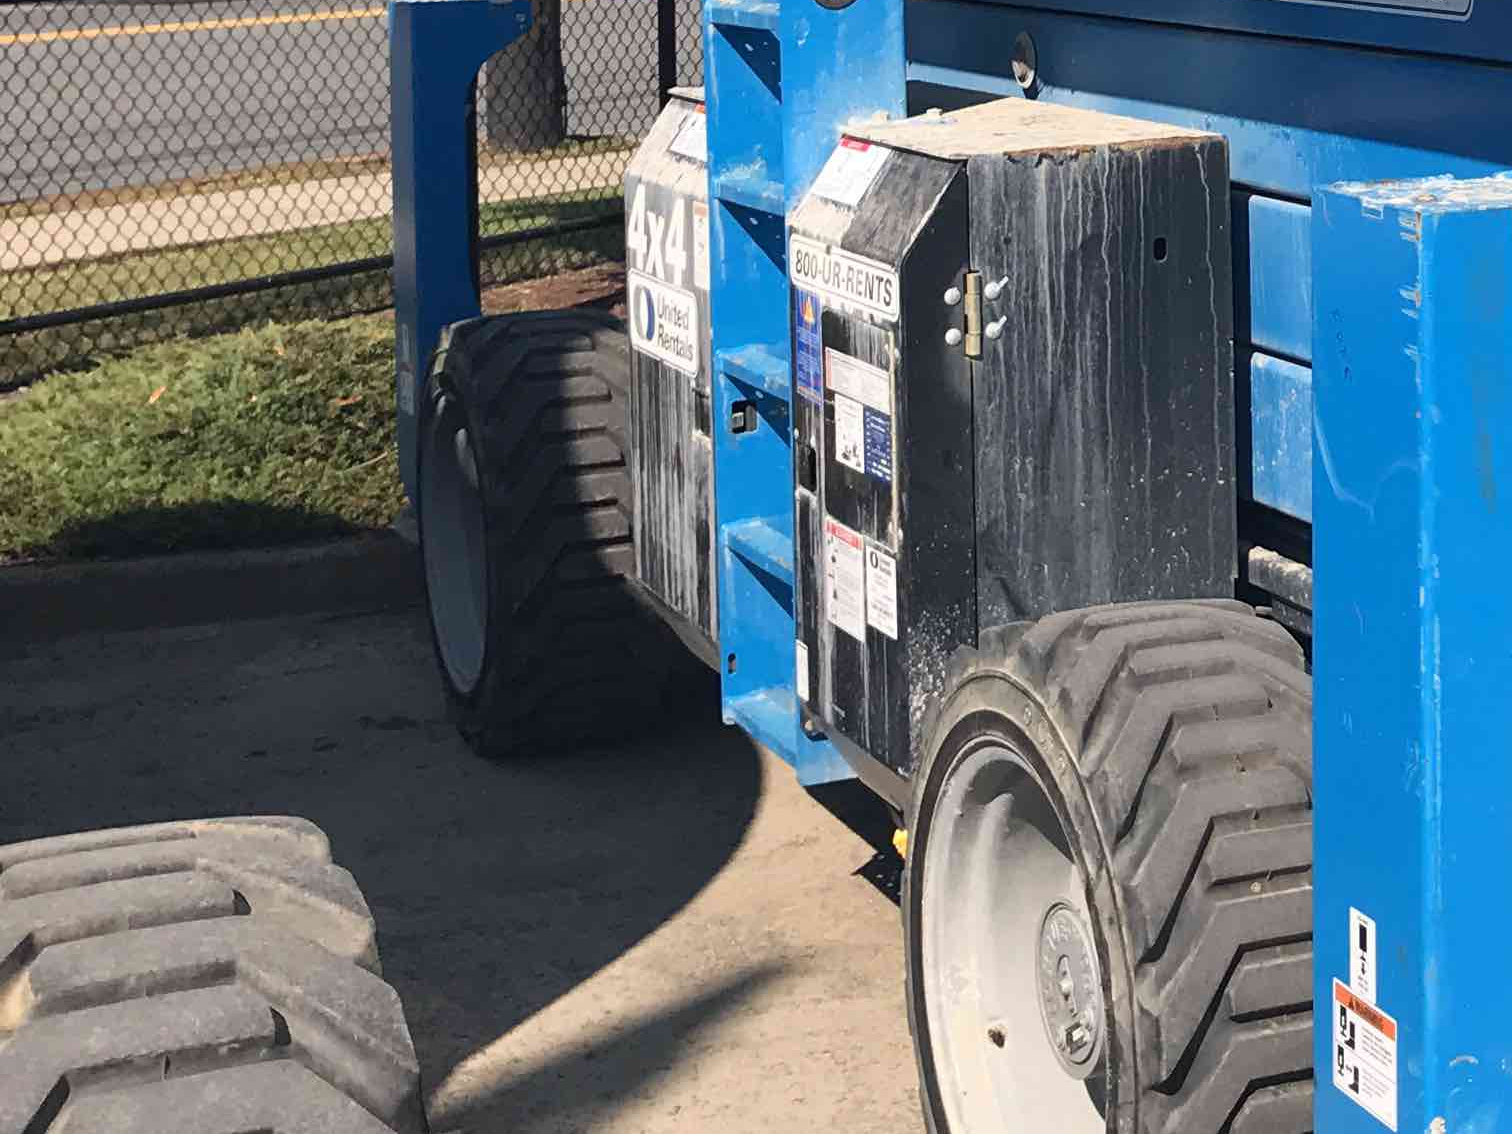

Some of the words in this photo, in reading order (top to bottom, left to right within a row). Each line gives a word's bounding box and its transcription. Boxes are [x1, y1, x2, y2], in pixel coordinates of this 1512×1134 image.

[795, 249, 893, 307] 800-UR-RENTS
[656, 293, 690, 331] United
[657, 323, 694, 363] Rentals
